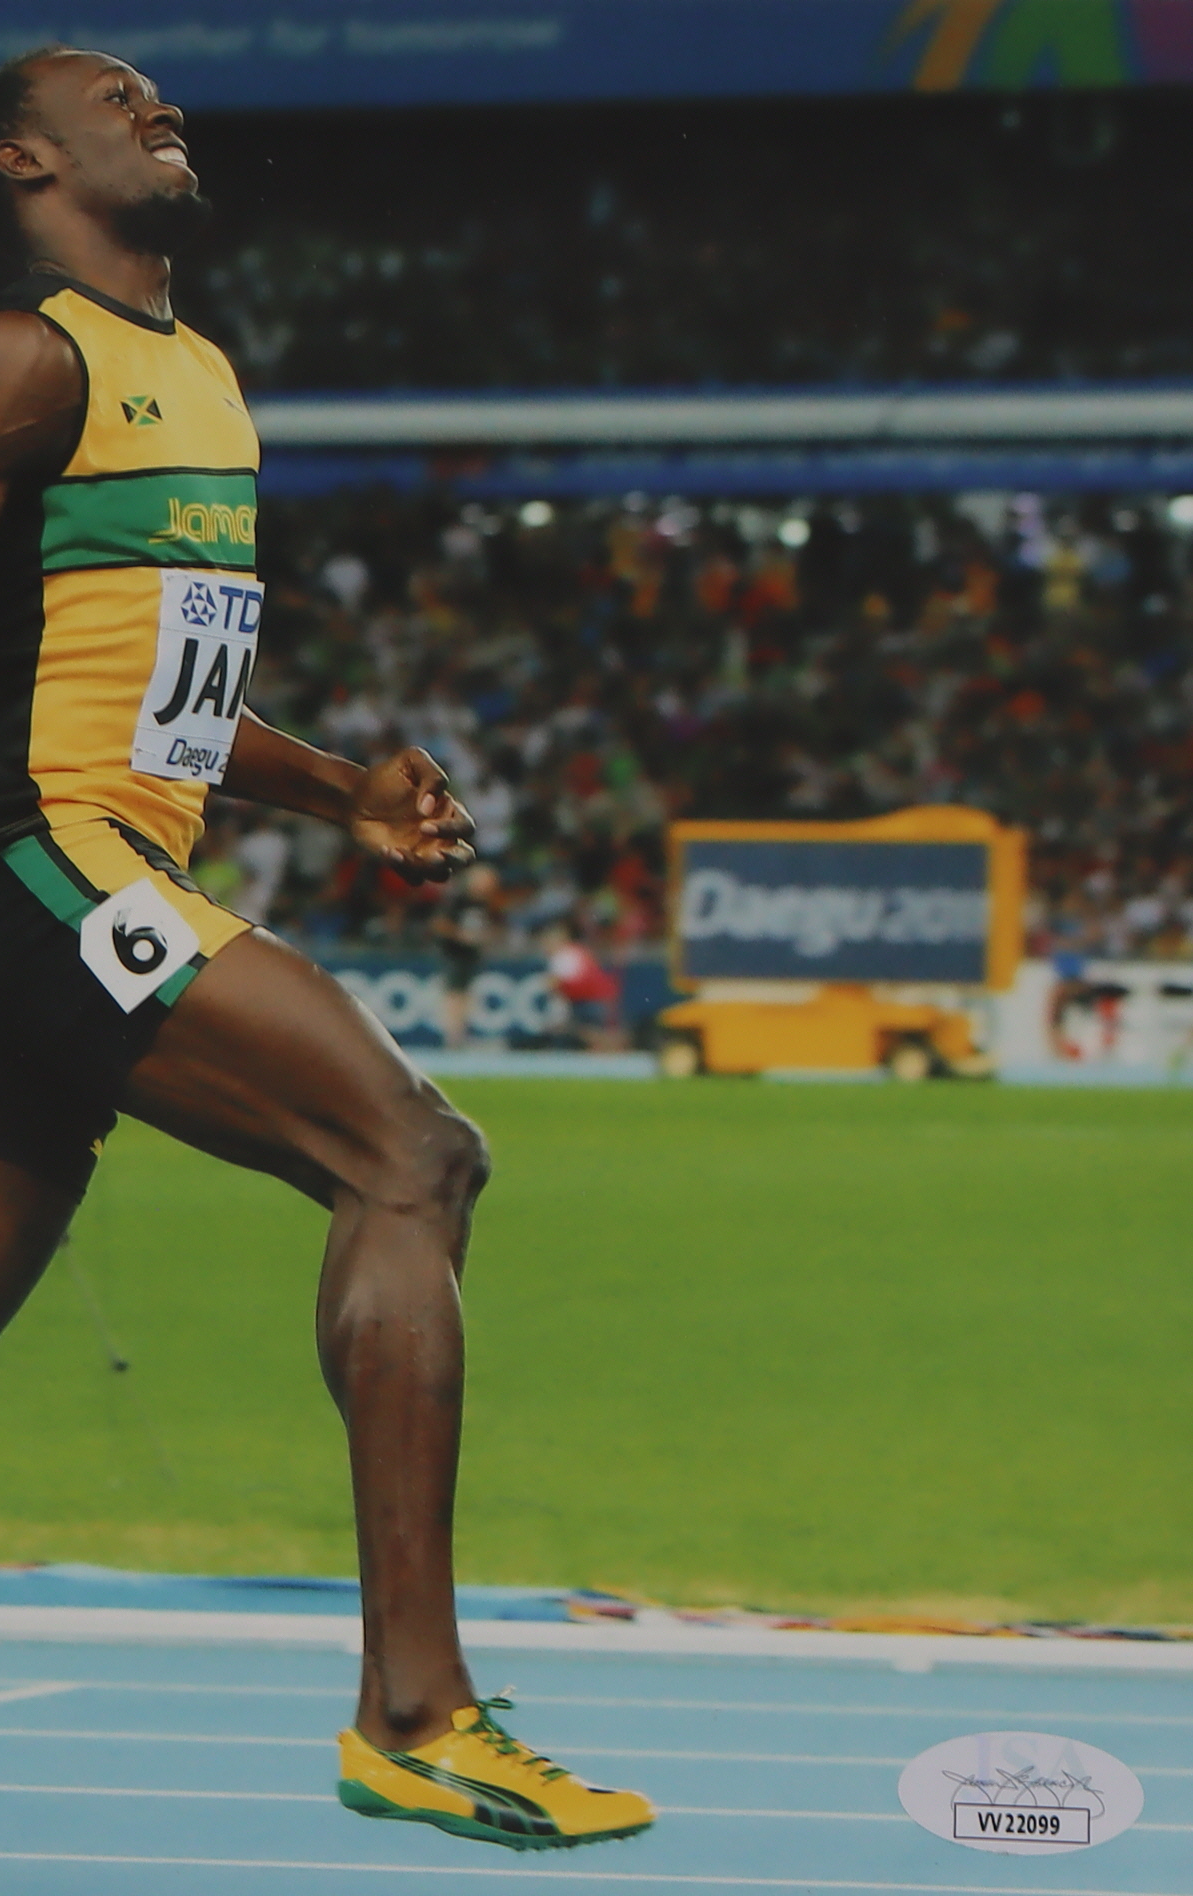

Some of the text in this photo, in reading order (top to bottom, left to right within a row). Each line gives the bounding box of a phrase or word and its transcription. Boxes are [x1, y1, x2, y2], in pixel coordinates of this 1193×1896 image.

[166, 738, 219, 776] Daegu
[680, 867, 895, 958] Daegu
[112, 908, 168, 975] 6
[977, 1811, 1061, 1836] VV22099
